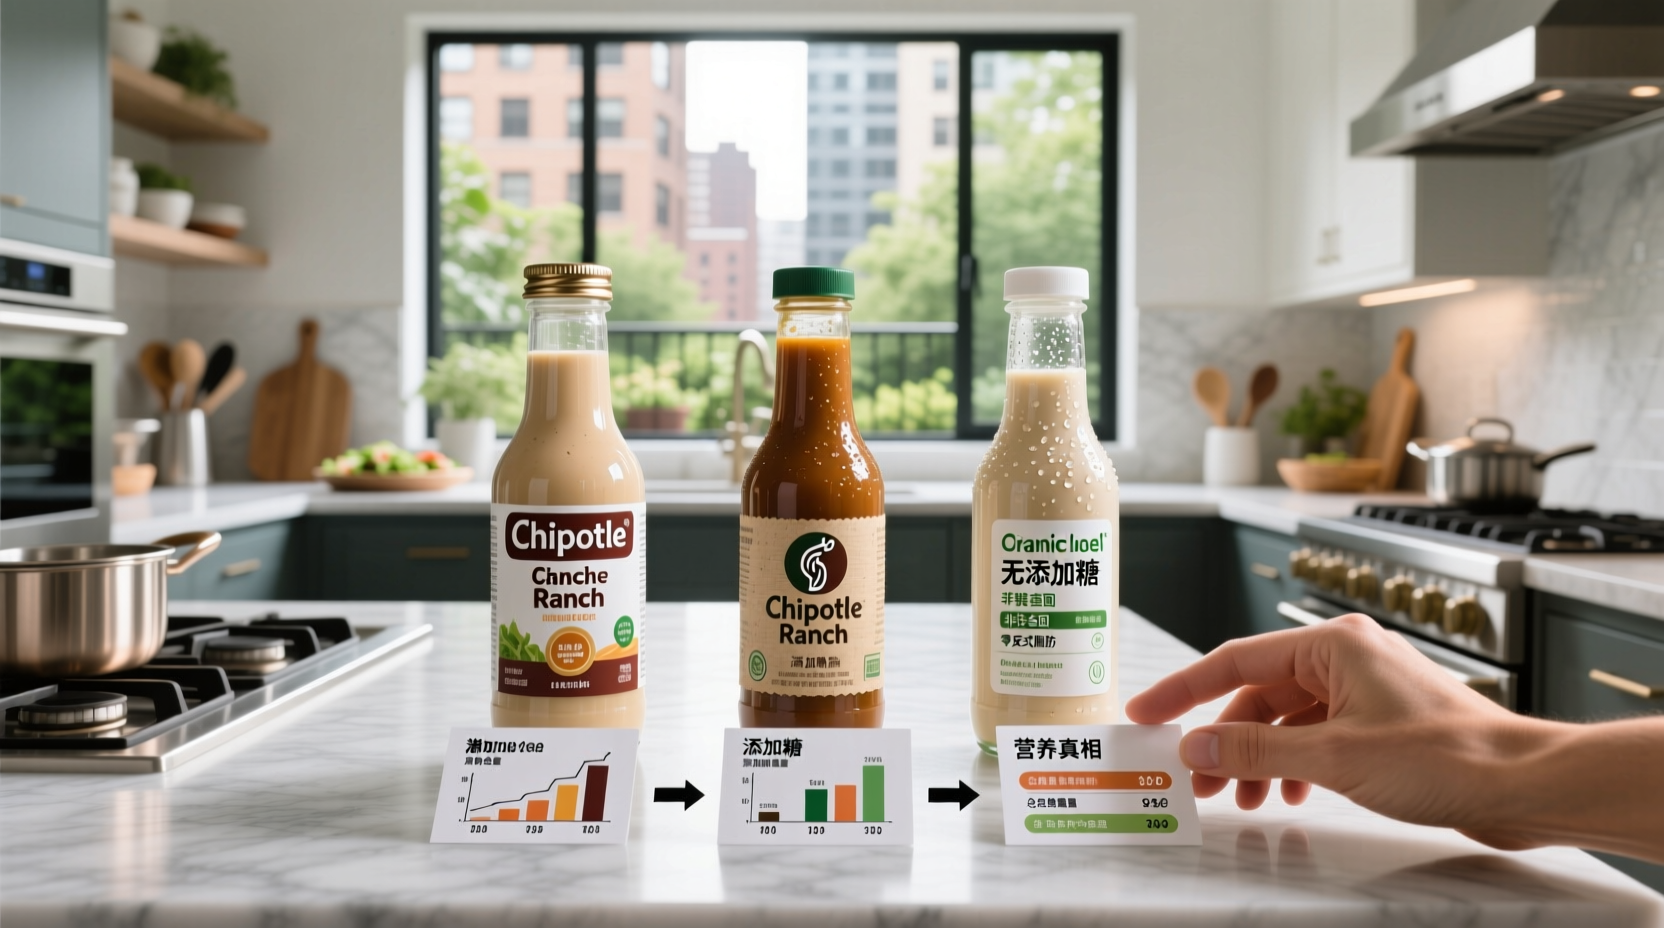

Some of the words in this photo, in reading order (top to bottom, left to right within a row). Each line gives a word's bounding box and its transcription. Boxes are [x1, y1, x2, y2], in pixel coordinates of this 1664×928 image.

[1001, 558, 1100, 587] 无添加糖
[533, 588, 604, 609] Ranch
[765, 595, 863, 627] Chipotle
[779, 623, 848, 645] Ranch
[742, 737, 803, 757] 添加糖
[1014, 737, 1102, 760] 营养真相
